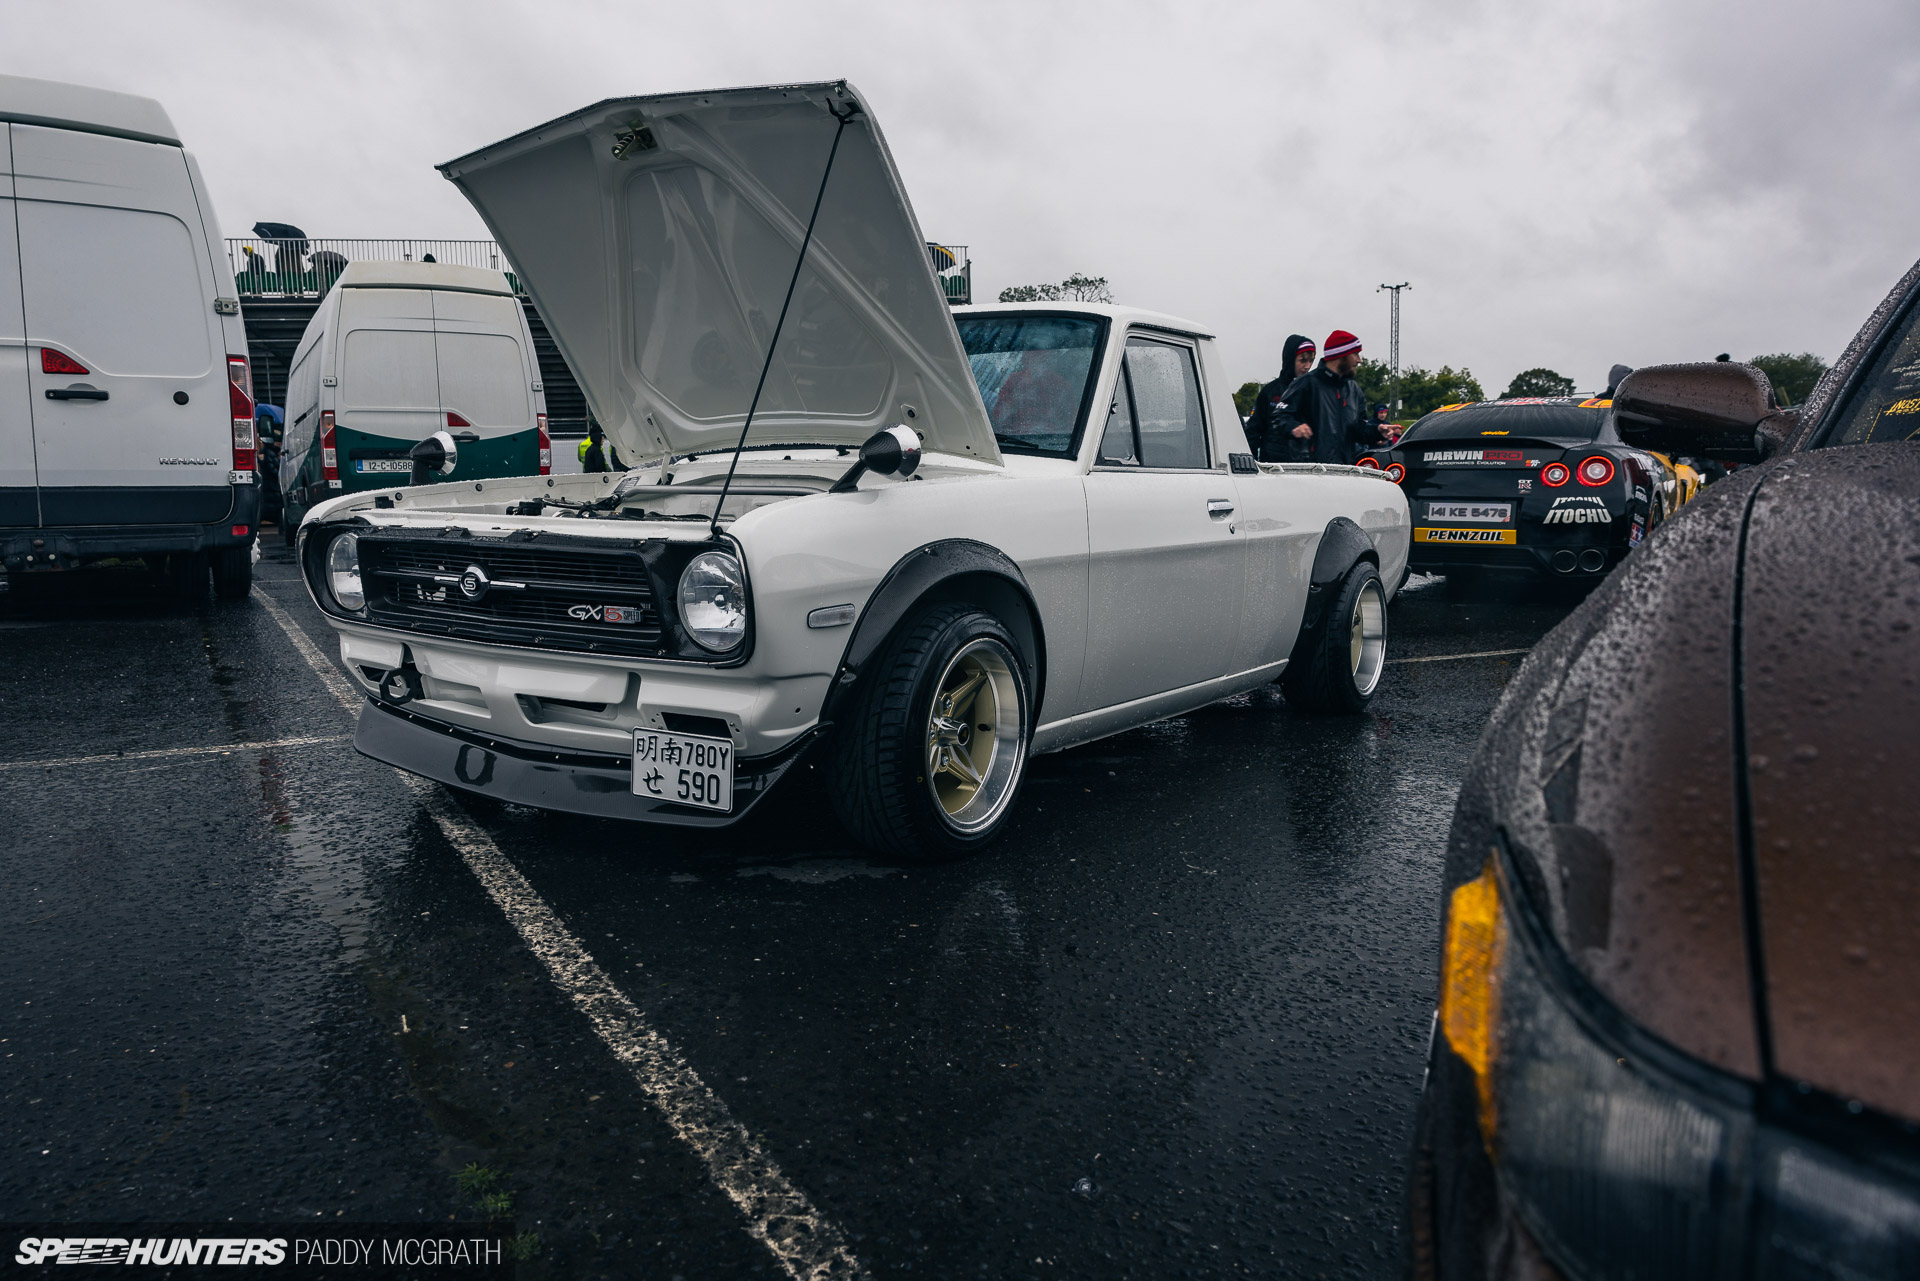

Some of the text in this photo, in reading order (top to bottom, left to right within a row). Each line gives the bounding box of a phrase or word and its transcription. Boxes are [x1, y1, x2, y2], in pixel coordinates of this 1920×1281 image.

[159, 457, 220, 466] RENAULT
[368, 461, 413, 470] 12-C-10588
[1431, 507, 1446, 516] 141
[1449, 507, 1468, 517] KE
[1543, 508, 1612, 524] ITOCHU
[1427, 529, 1505, 542] PENNZOIL
[567, 605, 603, 620] GX
[642, 766, 720, 804] せ 590
